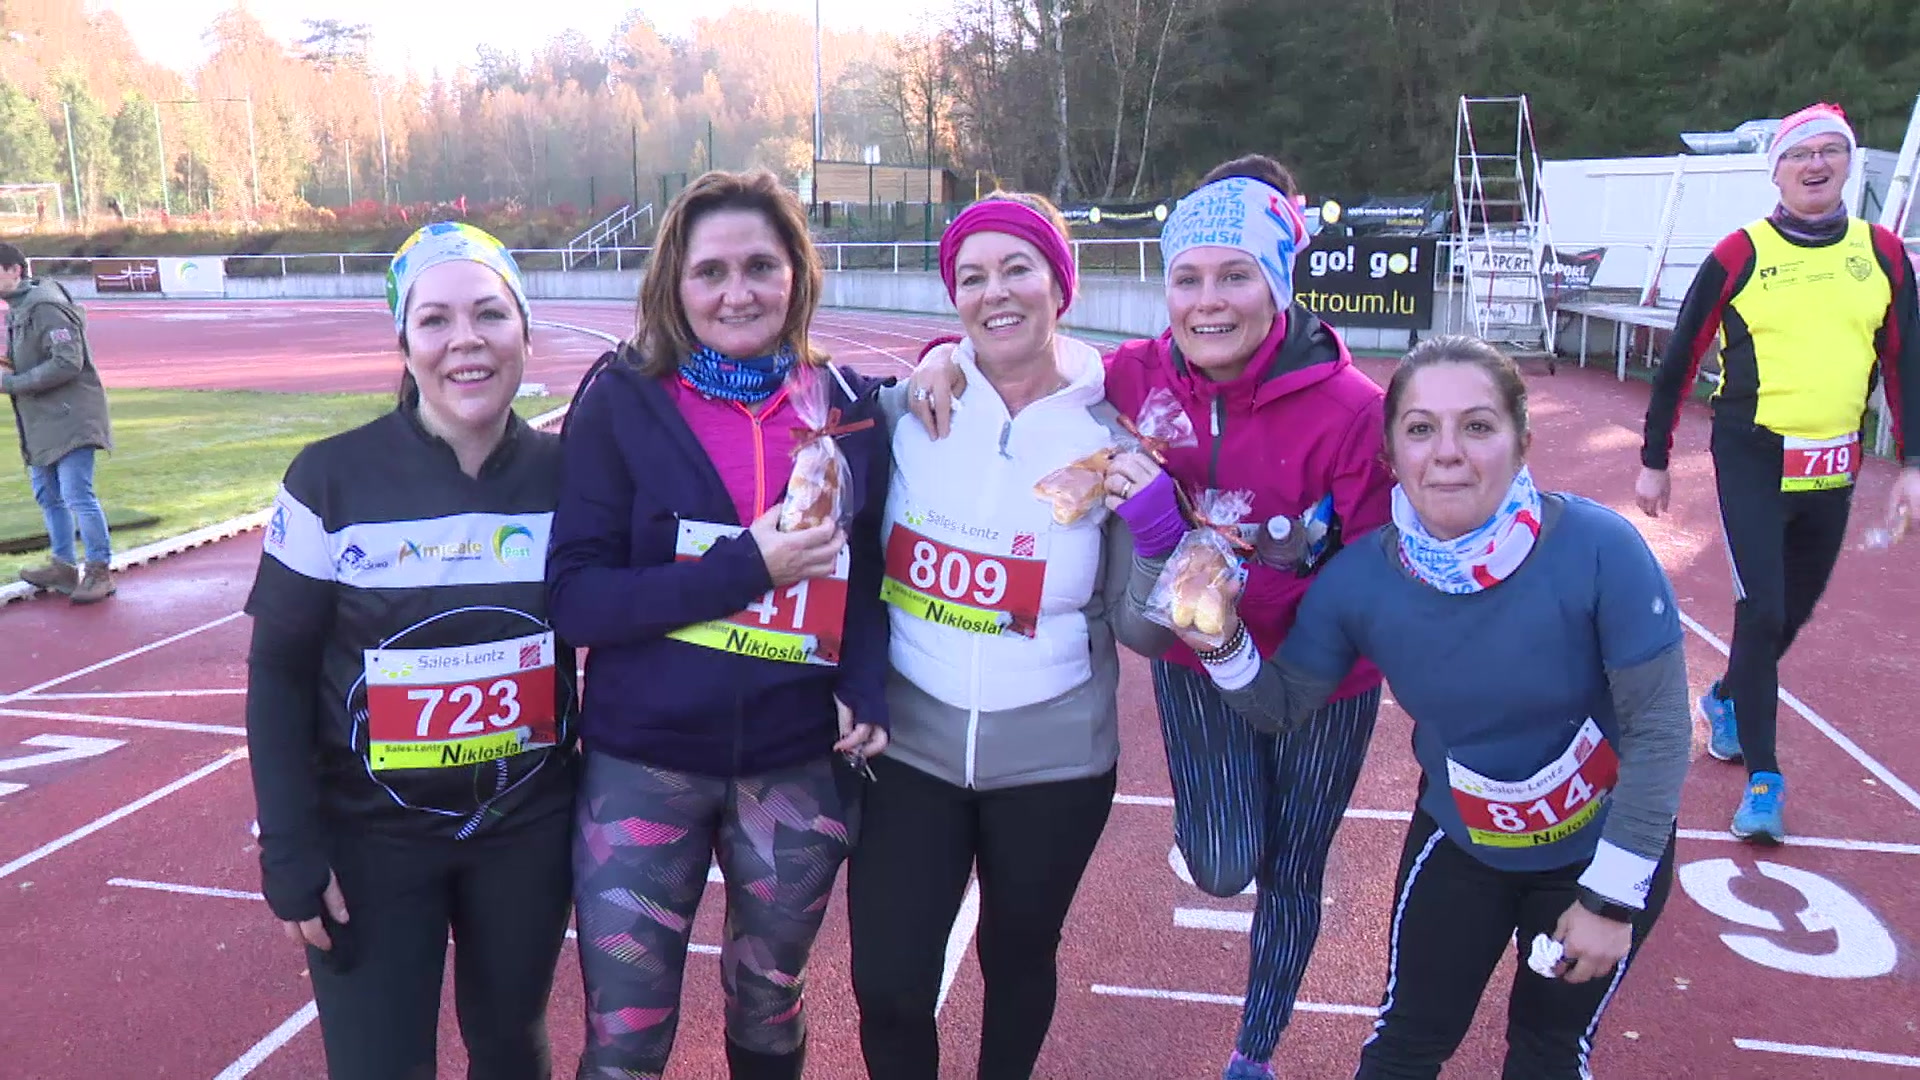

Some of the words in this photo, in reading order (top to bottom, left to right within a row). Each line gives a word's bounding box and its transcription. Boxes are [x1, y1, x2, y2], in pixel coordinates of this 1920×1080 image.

[1309, 245, 1355, 277] go!
[1369, 246, 1419, 278] go!
[1295, 289, 1415, 315] stroum.lu
[1803, 446, 1850, 475] 719
[909, 540, 1008, 605] 809
[746, 578, 810, 629] 41
[924, 600, 1006, 636] Nikloslaf
[407, 678, 521, 737] 723
[440, 737, 527, 765] Nikloslaf
[1487, 772, 1595, 832] 814
